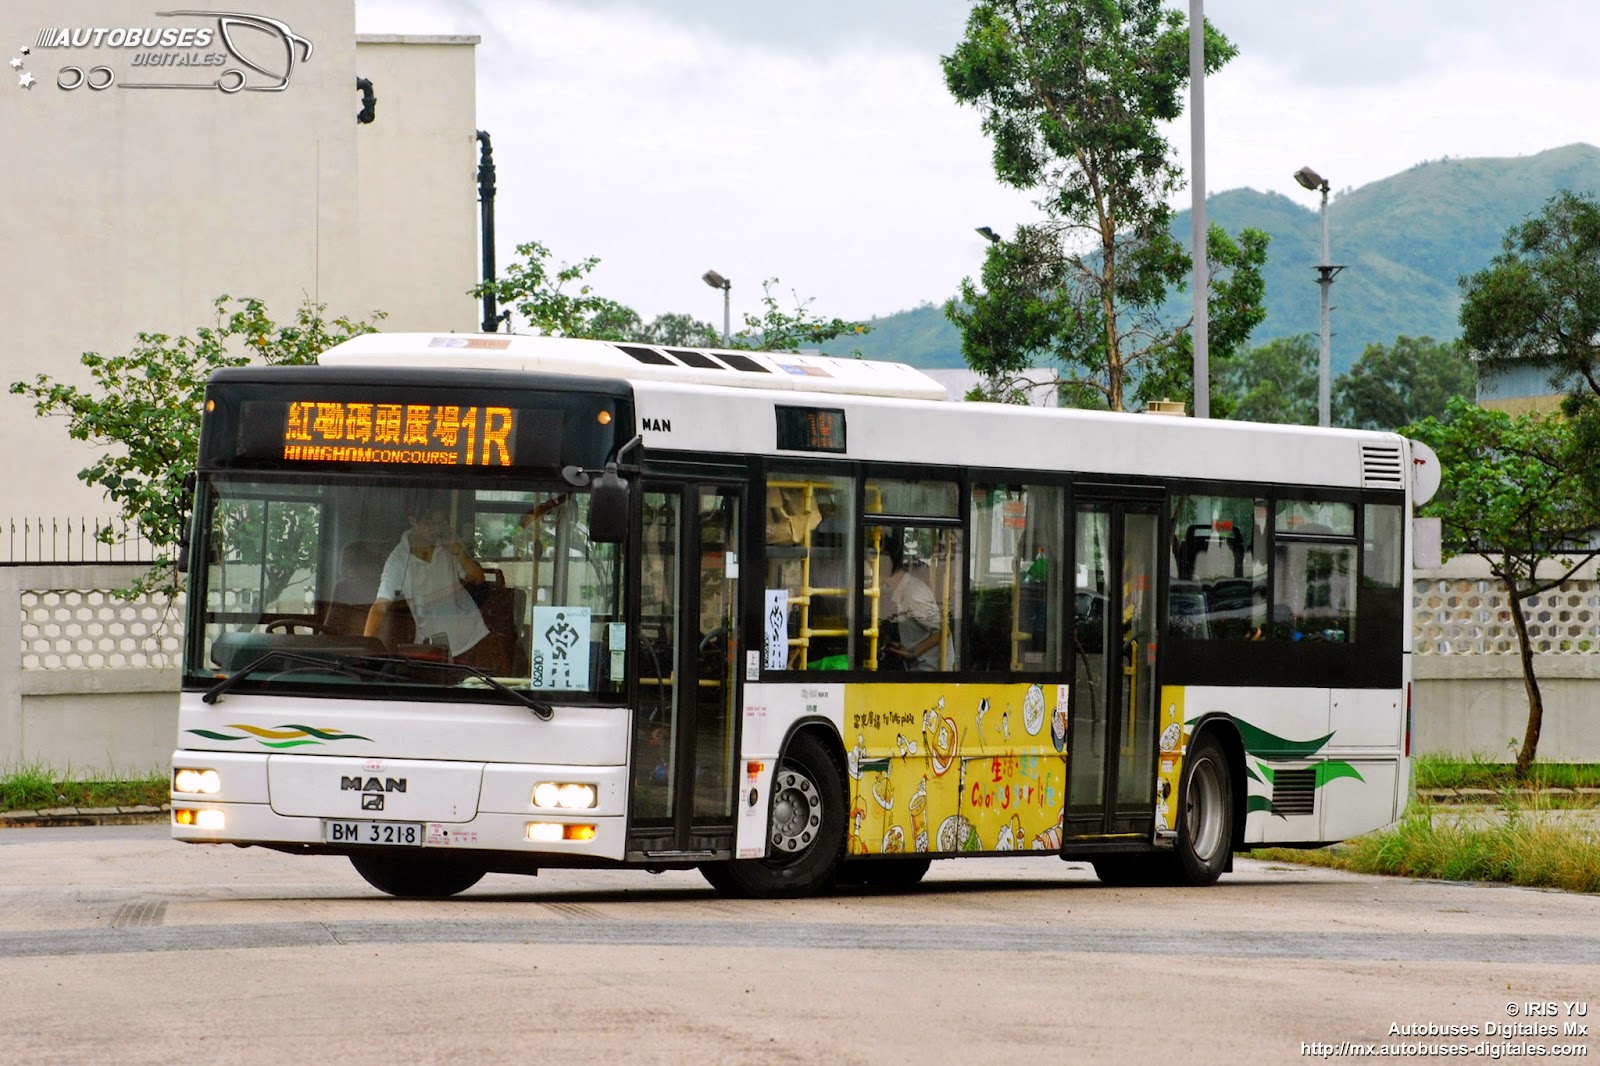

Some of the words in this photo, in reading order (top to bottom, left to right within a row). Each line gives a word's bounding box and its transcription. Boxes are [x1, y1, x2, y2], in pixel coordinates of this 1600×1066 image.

[642, 418, 671, 432] MAN
[461, 406, 513, 466] 1R
[340, 776, 407, 793] MAN
[971, 781, 1010, 810] Coloring
[1013, 783, 1035, 808] your
[1037, 772, 1055, 808] life
[332, 823, 359, 841] BM
[369, 825, 416, 843] 3218
